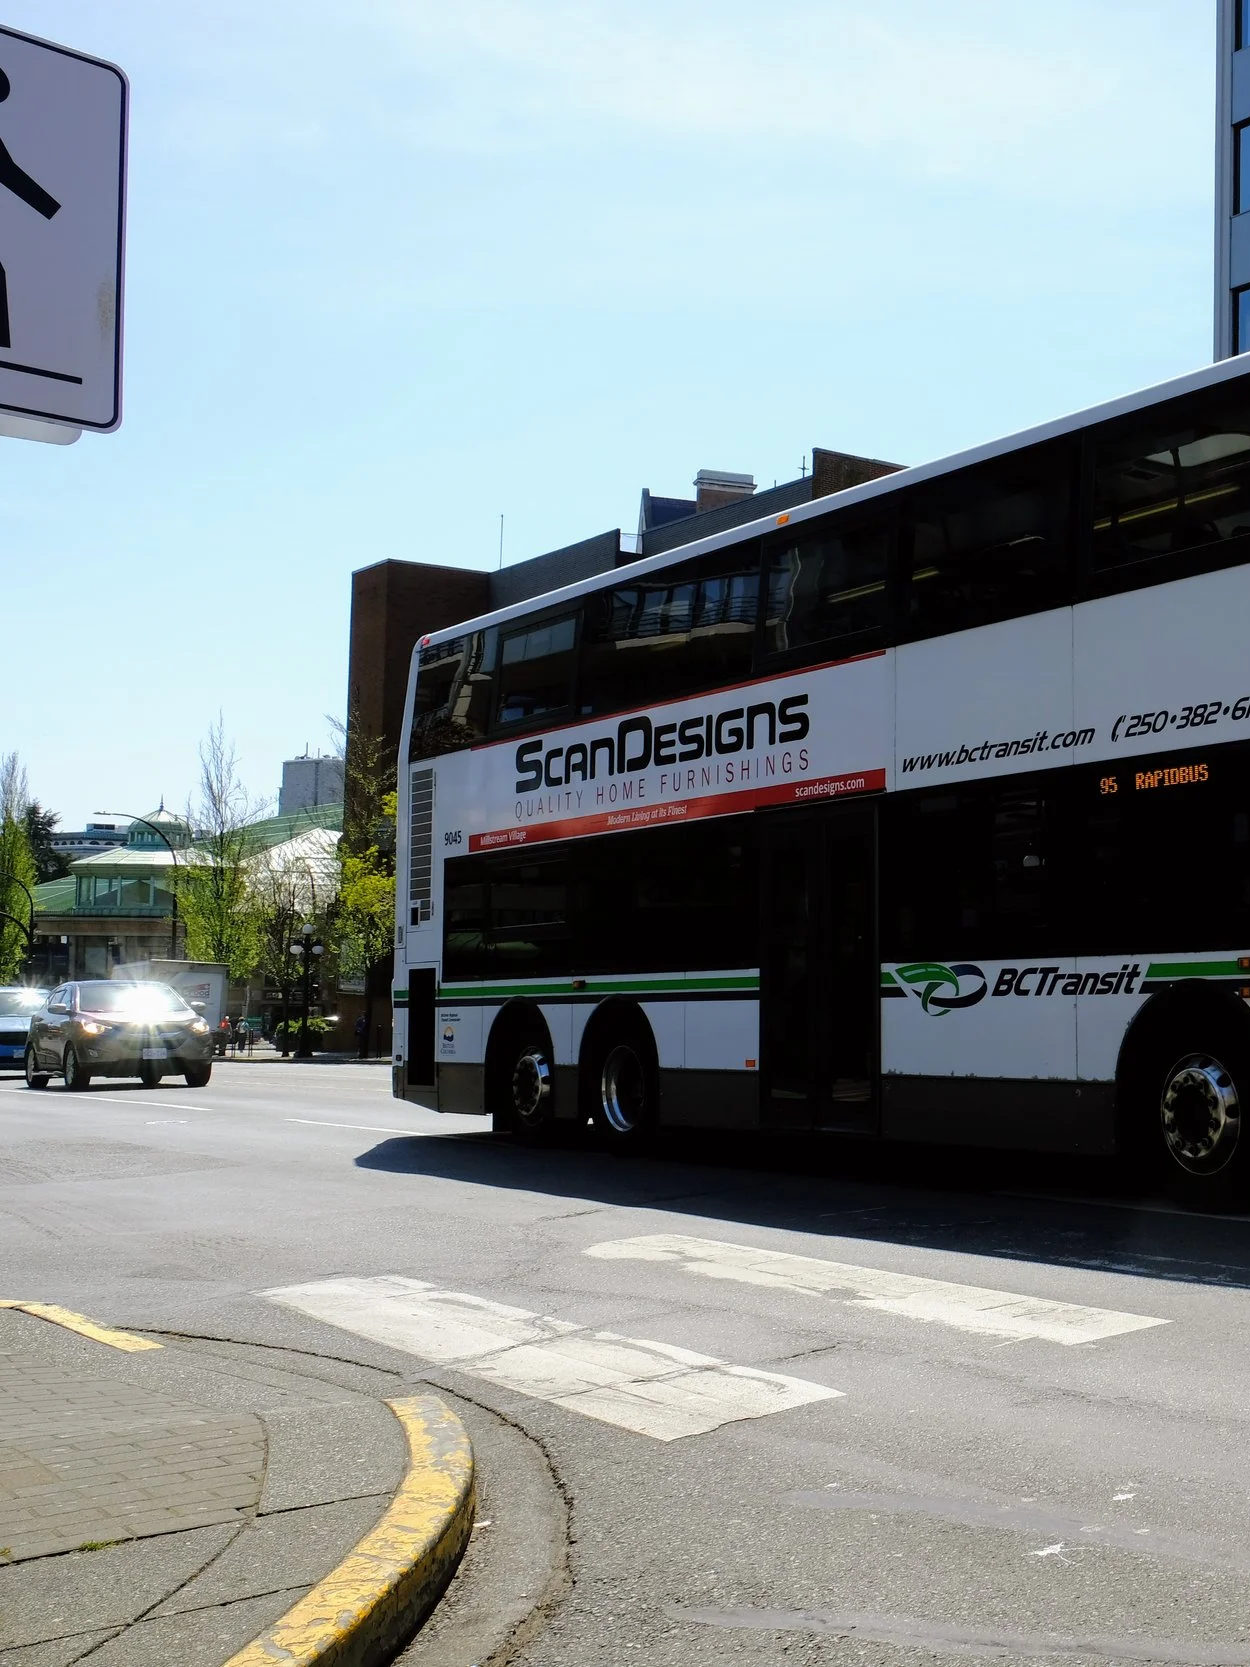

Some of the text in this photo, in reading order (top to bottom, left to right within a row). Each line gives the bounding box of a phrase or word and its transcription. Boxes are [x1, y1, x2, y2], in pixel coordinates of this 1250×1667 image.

[901, 727, 1097, 773] www.bctransit.com
[515, 749, 810, 823] QUALITY HOME FURNISHINGS
[794, 776, 865, 798] scandesigns.com
[1099, 763, 1209, 795] 95 RAPIDBUS
[607, 814, 631, 826] Modern
[631, 810, 651, 822] Living
[659, 807, 667, 818] its
[667, 804, 688, 817] Finest
[444, 830, 462, 846] 9045
[480, 830, 527, 846] Millstream Village
[991, 963, 1141, 998] BCTransit
